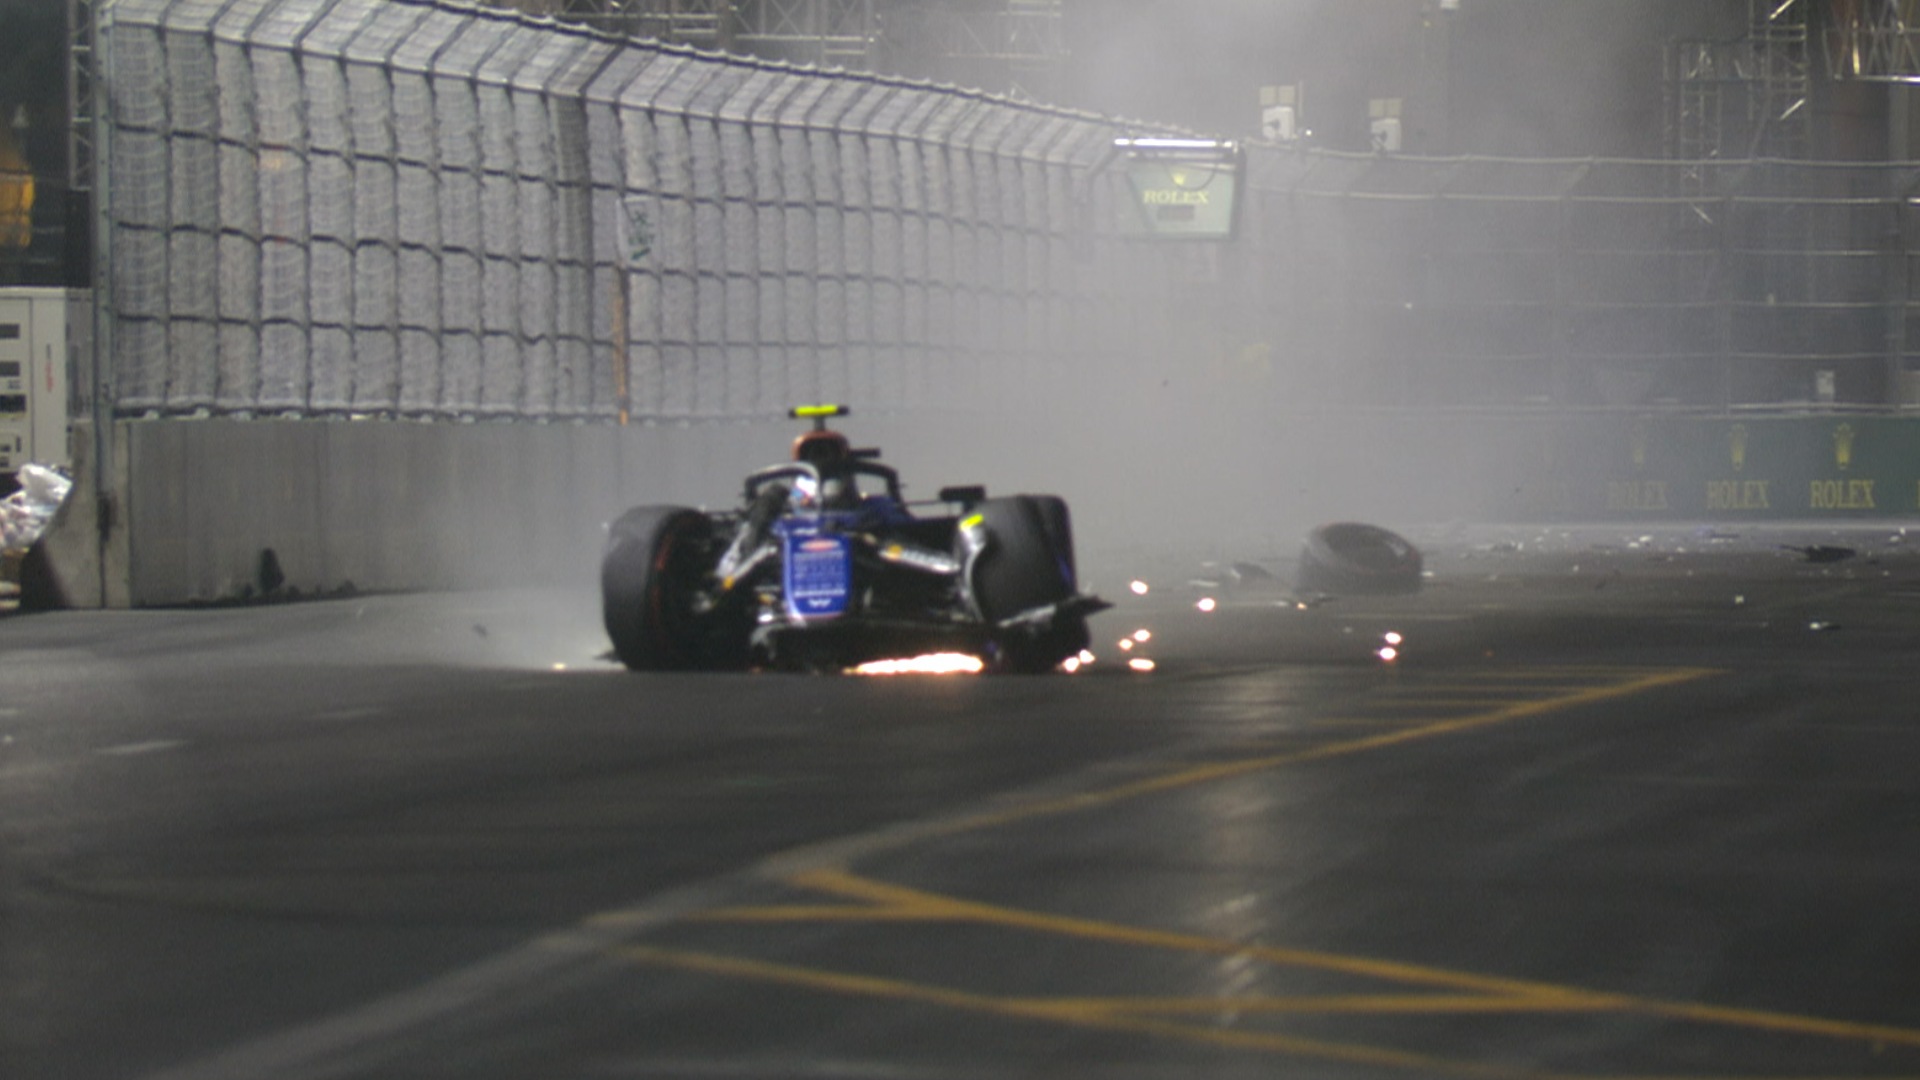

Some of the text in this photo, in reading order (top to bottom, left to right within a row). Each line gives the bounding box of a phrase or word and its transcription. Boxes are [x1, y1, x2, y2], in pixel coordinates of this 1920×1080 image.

[1143, 190, 1209, 204] ROLEX
[1707, 480, 1770, 509] ROLEX
[1810, 480, 1875, 508] ROLEX
